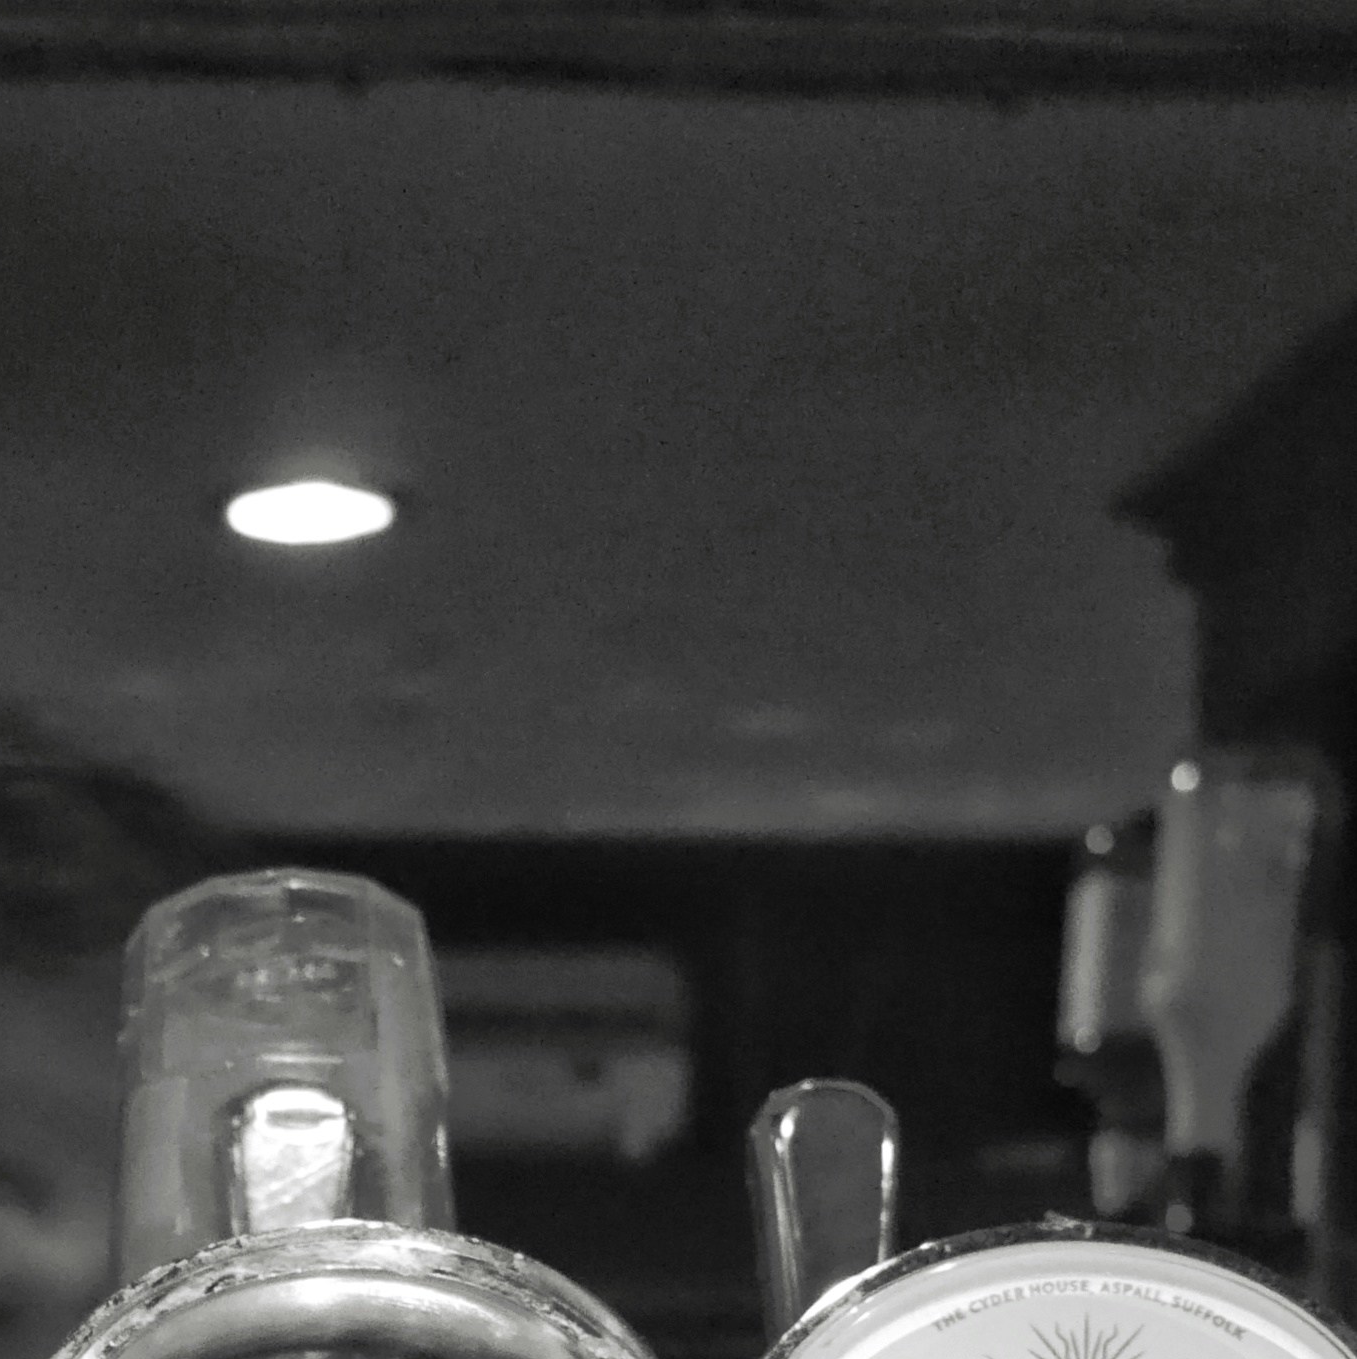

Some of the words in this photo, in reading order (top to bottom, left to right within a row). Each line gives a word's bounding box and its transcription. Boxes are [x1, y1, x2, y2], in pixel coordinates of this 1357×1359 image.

[932, 1307, 967, 1332] THE
[969, 1287, 1026, 1314] CYDER
[1171, 1295, 1248, 1341] SUFFOLK
